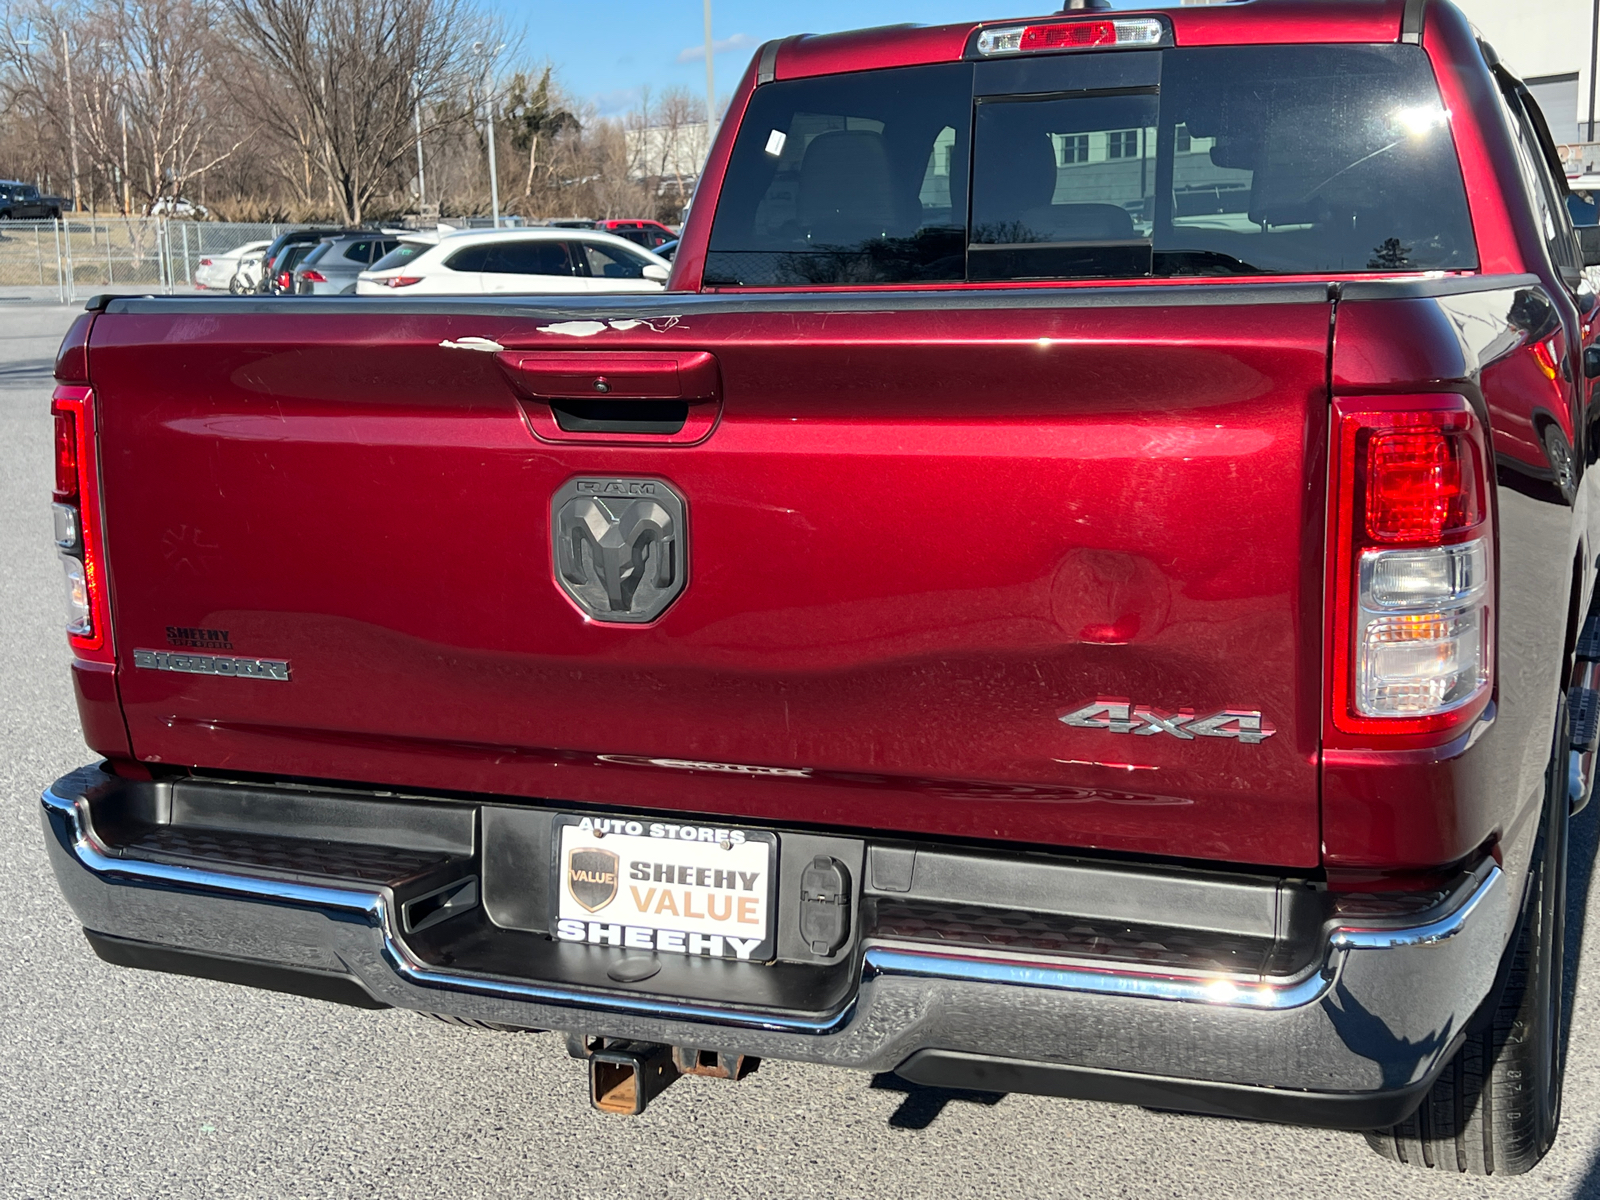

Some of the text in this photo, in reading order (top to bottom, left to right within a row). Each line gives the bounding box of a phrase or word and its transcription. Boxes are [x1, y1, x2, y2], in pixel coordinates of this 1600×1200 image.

[577, 481, 655, 495] RAM
[166, 626, 229, 642] SHEEHY
[579, 817, 745, 844] AUTO STORES
[570, 869, 616, 885] VALUE
[629, 860, 760, 891] SHEEHY
[629, 885, 760, 925] VALUE
[557, 919, 762, 960] SHEEHY
